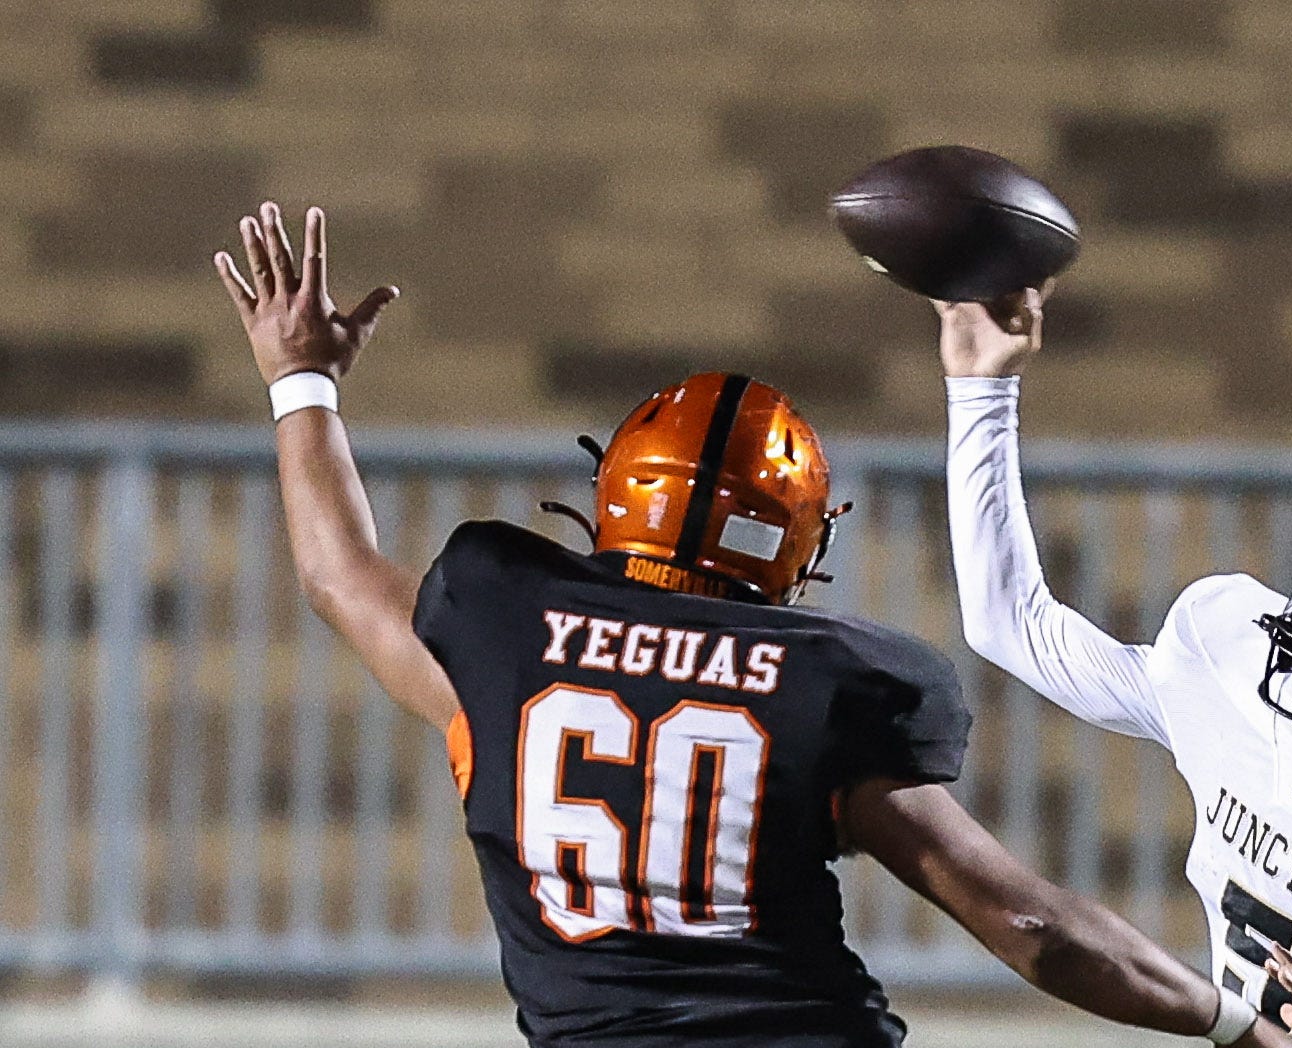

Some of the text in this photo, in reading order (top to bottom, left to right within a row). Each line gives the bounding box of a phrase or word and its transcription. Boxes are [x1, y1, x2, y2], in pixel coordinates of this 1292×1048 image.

[624, 556, 728, 598] SOMER
[541, 608, 788, 694] YEGUAS
[516, 682, 771, 944] 60
